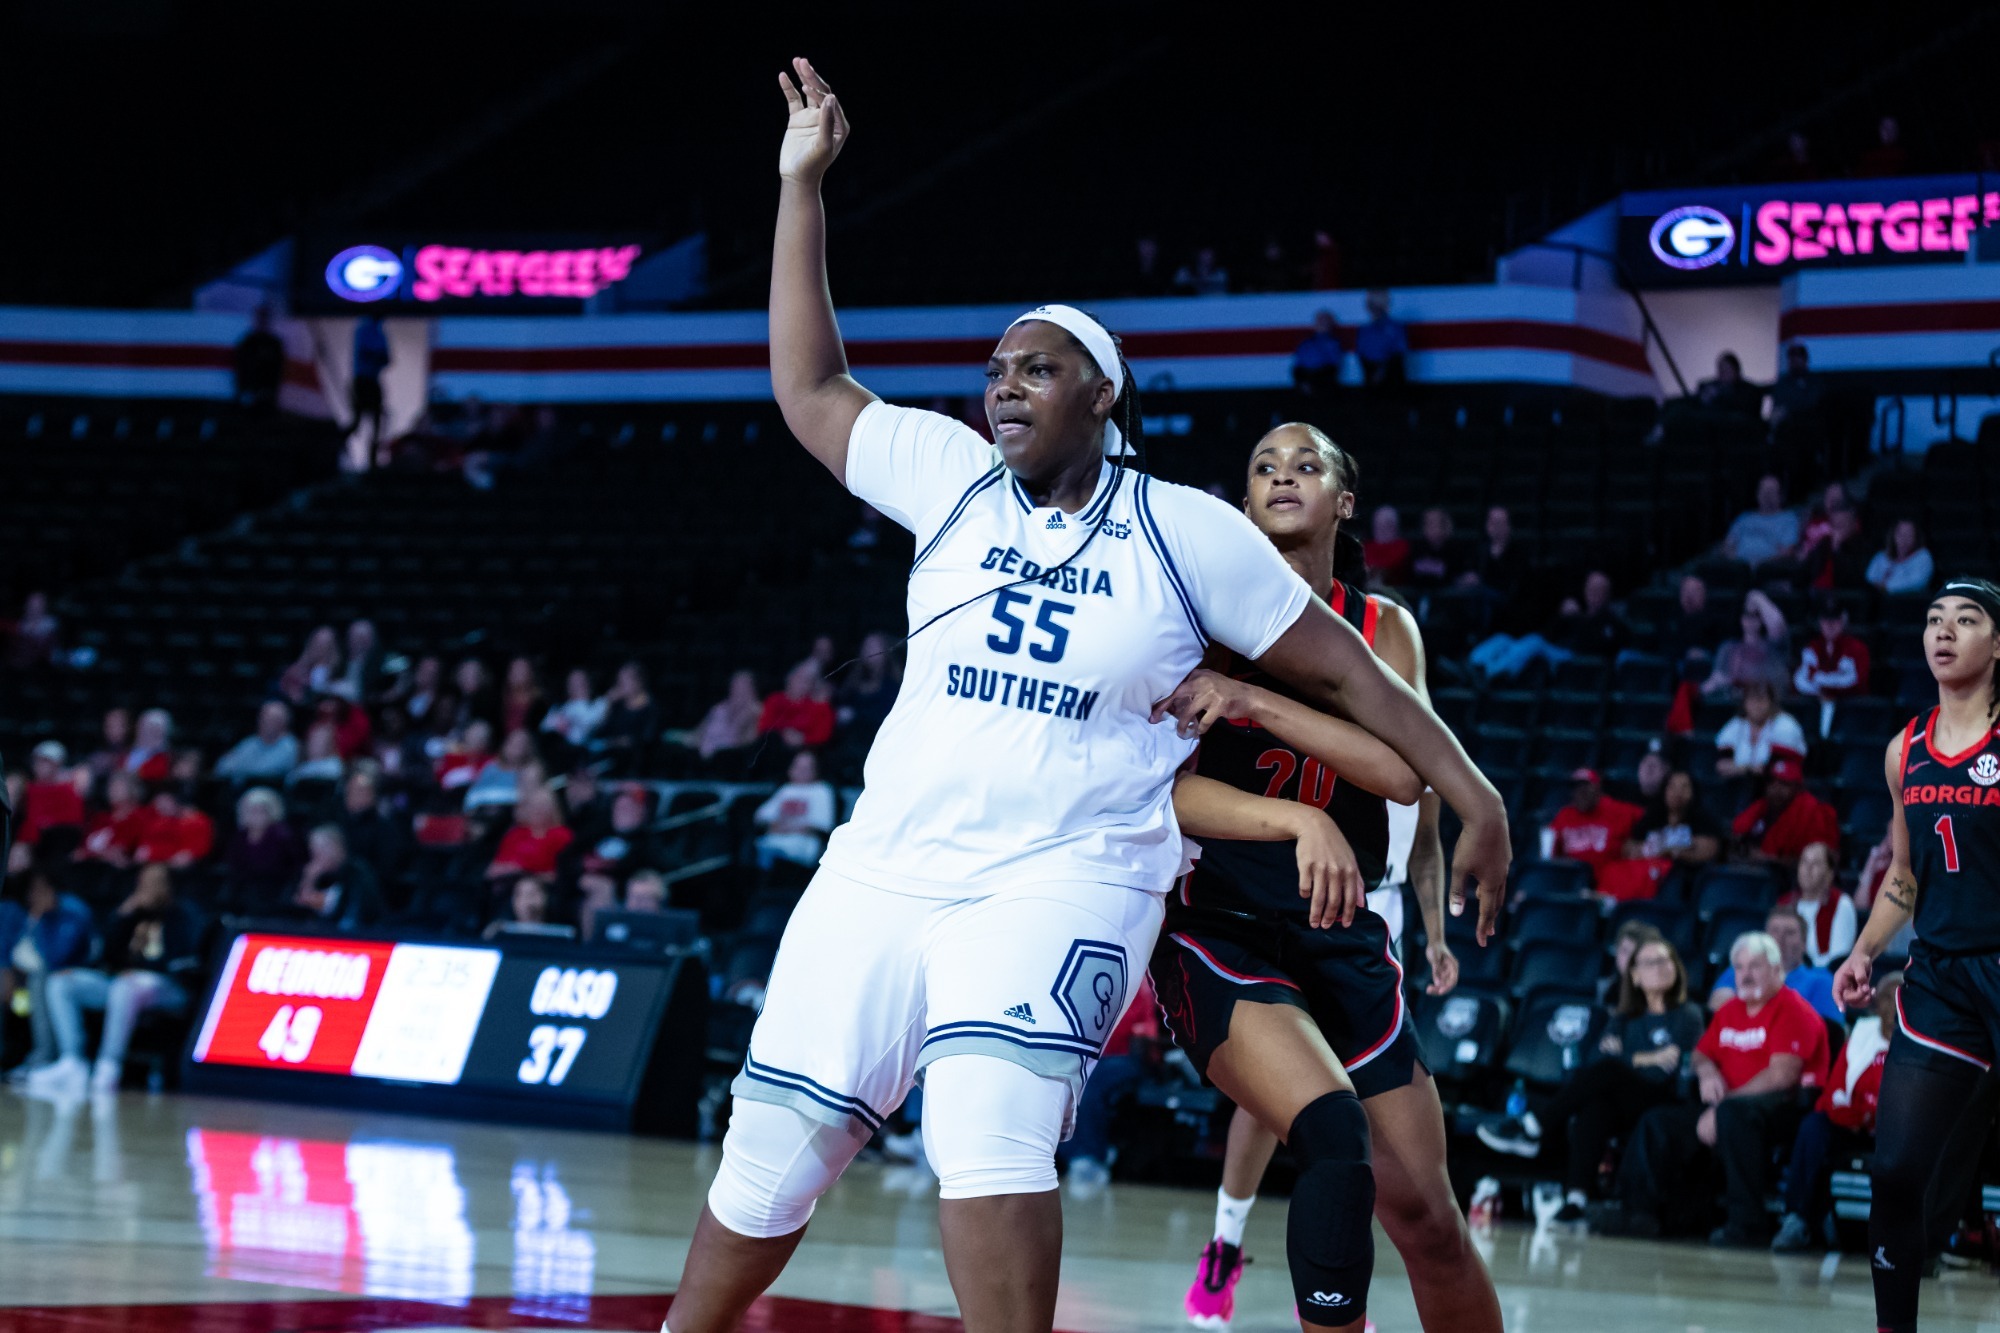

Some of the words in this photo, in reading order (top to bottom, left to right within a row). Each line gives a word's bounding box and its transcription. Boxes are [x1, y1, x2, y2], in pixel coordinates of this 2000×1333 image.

[980, 546, 1113, 597] GEORGIA
[986, 588, 1076, 664] 55
[946, 663, 1100, 721] SOUTHERN
[1256, 748, 1338, 810] 20
[1975, 753, 1999, 778] SEC
[1903, 785, 2000, 807] GEORGIA
[1934, 814, 1960, 873] 1
[529, 965, 618, 1020] GASO
[1003, 1008, 1037, 1025] adidas
[260, 1006, 322, 1063] 49
[518, 1024, 587, 1086] 37
